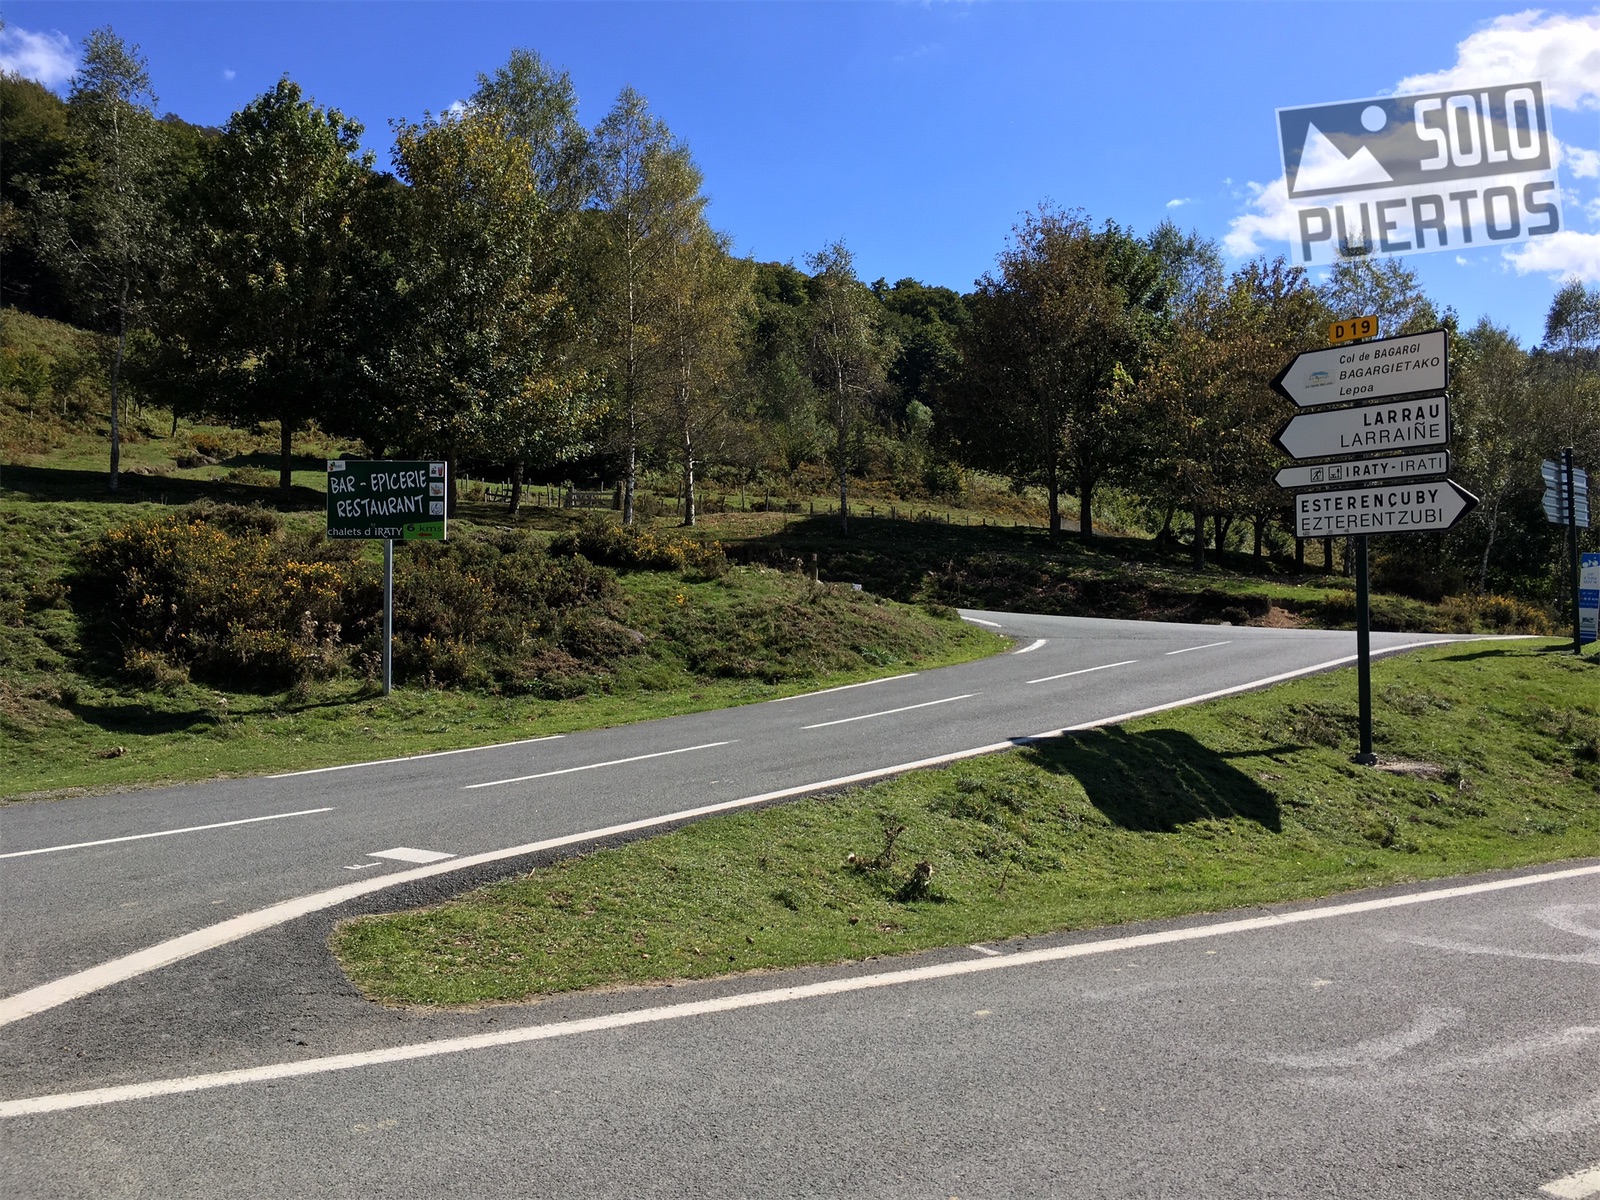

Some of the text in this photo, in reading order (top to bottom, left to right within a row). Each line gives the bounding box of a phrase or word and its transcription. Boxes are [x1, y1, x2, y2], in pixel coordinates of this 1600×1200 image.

[1335, 320, 1371, 339] D 19
[1339, 343, 1421, 365] Col de BAGARGI
[1339, 357, 1440, 380] BAGARGIETAKO
[1339, 384, 1374, 396] Lepoa
[1363, 404, 1440, 427] LARRAU
[1340, 422, 1440, 448] LARRAIÑE
[330, 476, 356, 494] BAR
[370, 470, 427, 492] EPICERIE
[336, 494, 424, 517] RESTAURANT
[1301, 489, 1439, 513] ESTERENÇUBY
[407, 523, 416, 532] 6
[1301, 508, 1443, 531] EZTERENTZUBI
[327, 527, 362, 536] chalets
